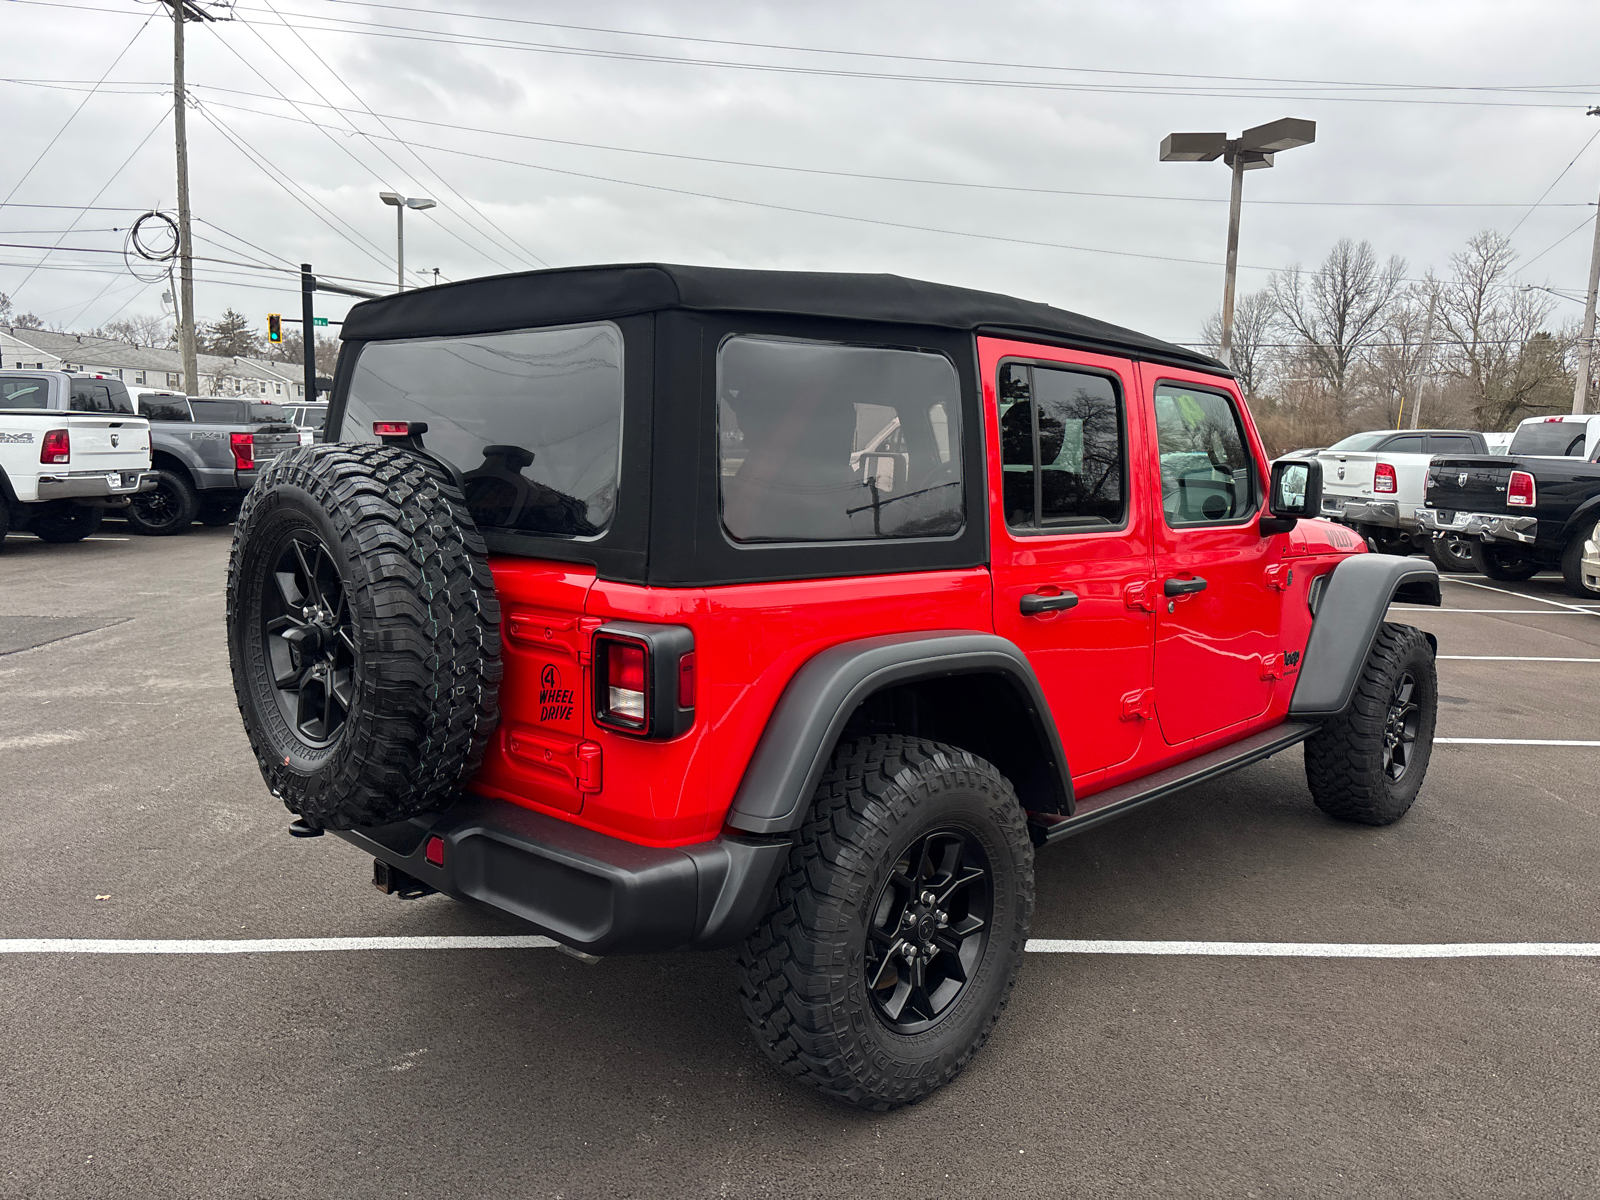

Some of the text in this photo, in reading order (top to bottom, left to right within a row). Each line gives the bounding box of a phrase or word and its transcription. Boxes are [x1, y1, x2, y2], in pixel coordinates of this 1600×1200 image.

[1324, 530, 1353, 547] WILLYS
[1284, 650, 1300, 666] Jeep
[544, 668, 555, 688] 4
[540, 689, 574, 704] WHEEL
[540, 705, 574, 722] DRIVE
